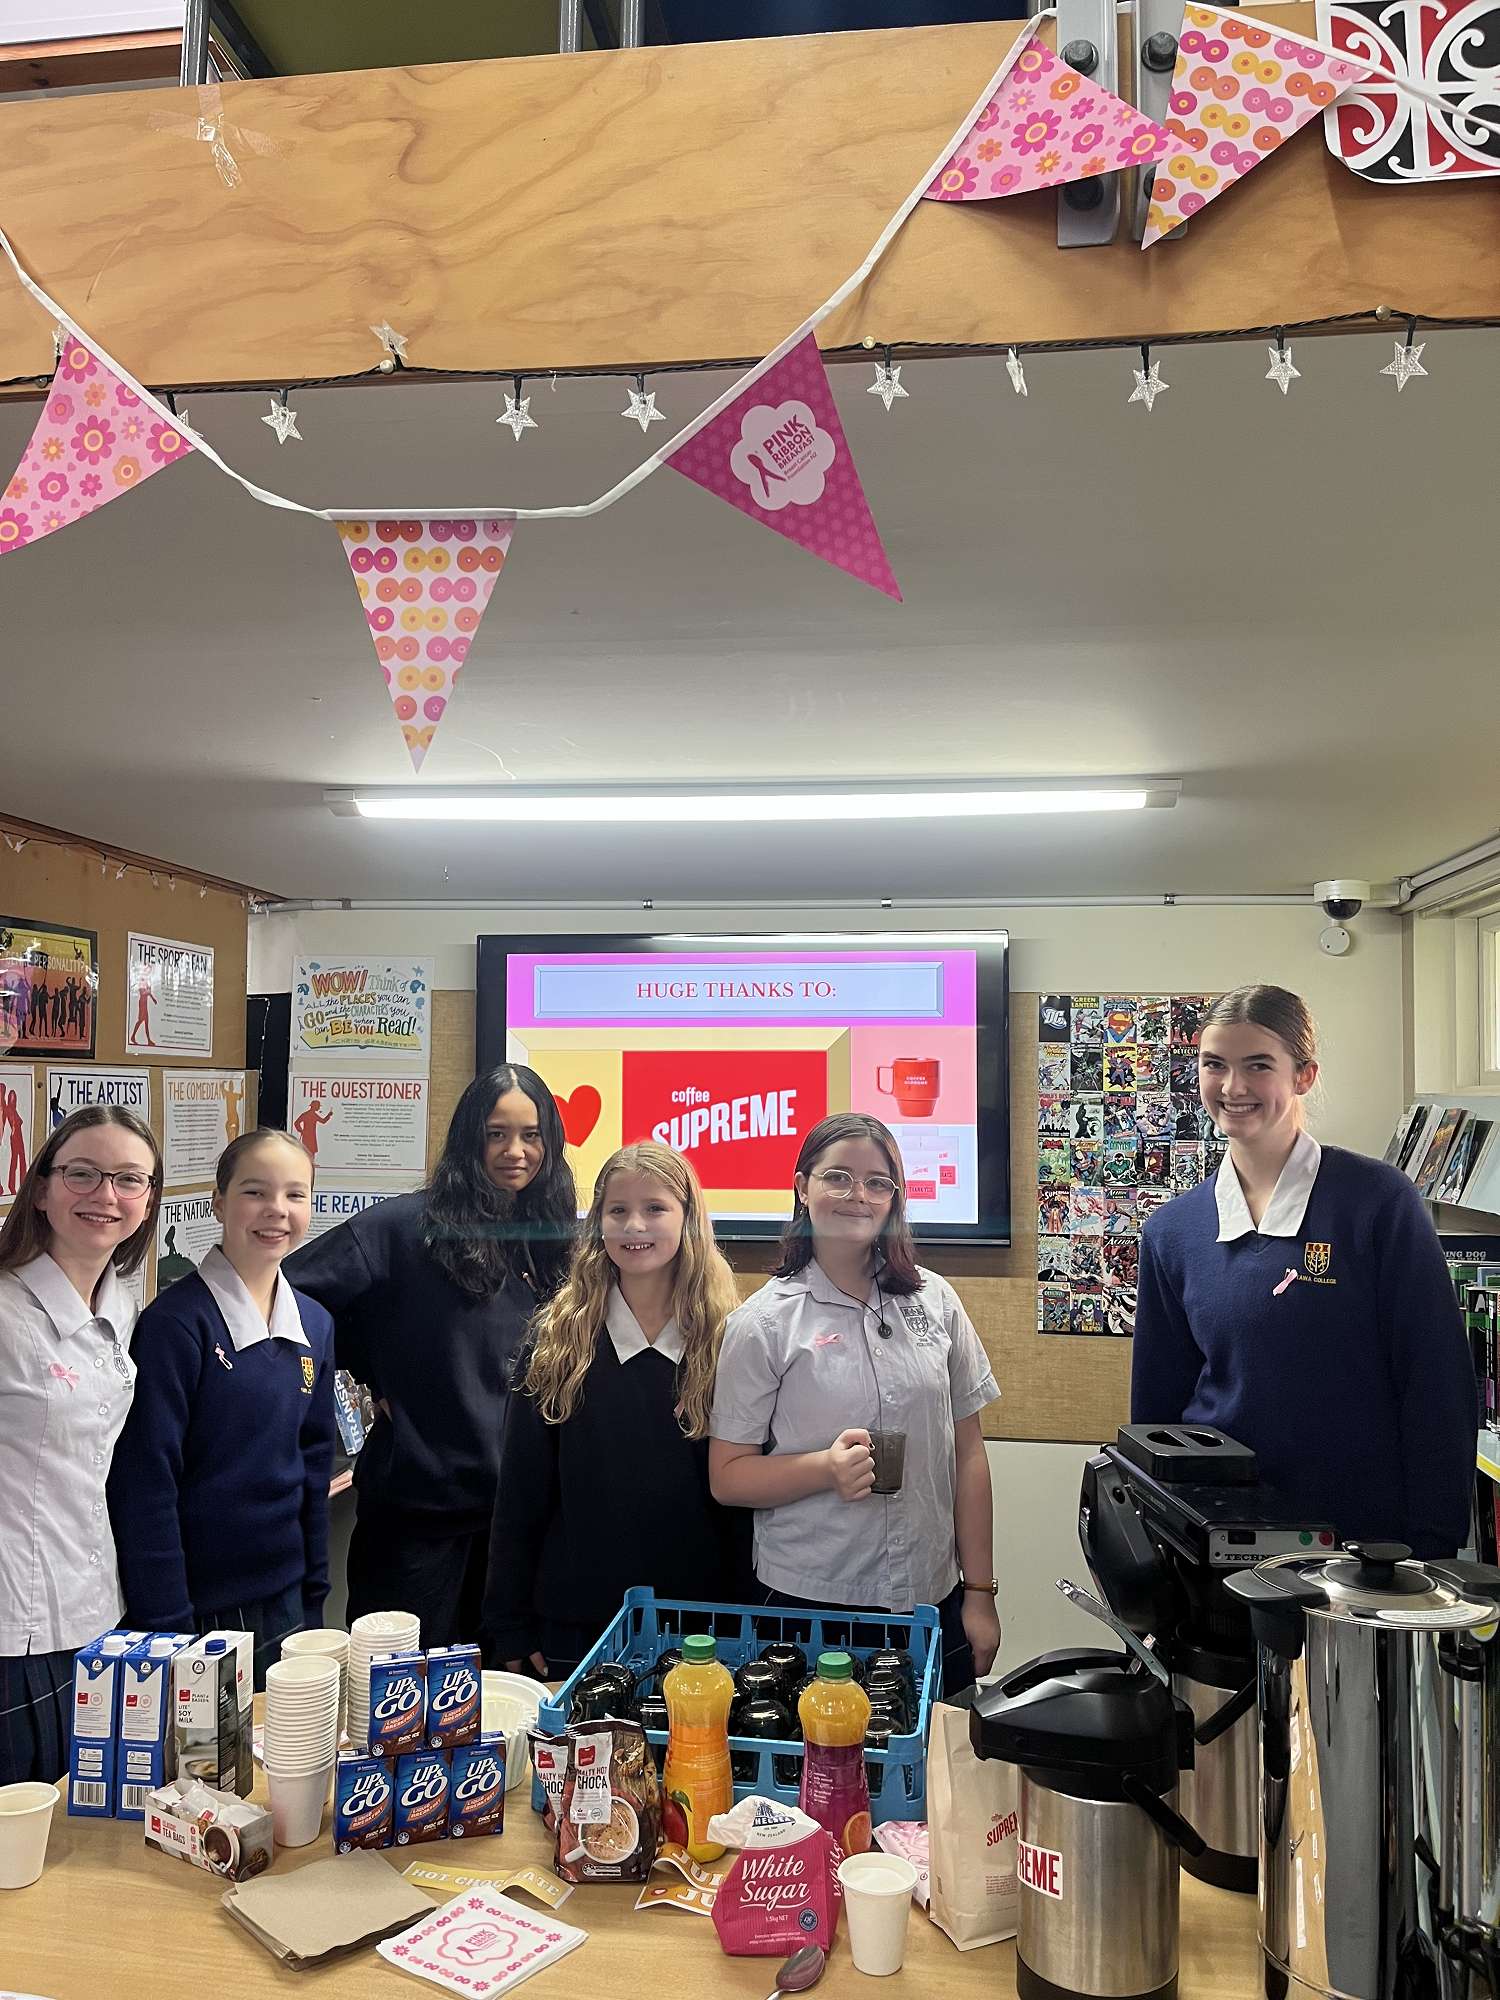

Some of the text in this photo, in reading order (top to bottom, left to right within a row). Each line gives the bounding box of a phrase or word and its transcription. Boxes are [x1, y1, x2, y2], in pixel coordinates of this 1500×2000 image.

[763, 414, 805, 454] PINK
[772, 426, 811, 463] RIBBON
[778, 434, 815, 469] BREAKFAST
[138, 944, 156, 965] THE
[191, 953, 208, 973] FAN
[312, 970, 368, 998] WOW!
[368, 974, 399, 992] Think
[637, 981, 837, 998] HUGE THANKS TO:
[340, 992, 376, 1005] PLACES
[303, 1010, 325, 1028] GO
[330, 1020, 353, 1035] BE
[375, 1017, 416, 1036] Read!
[68, 1080, 143, 1105] THE ARTIST
[168, 1082, 184, 1100] THE
[301, 1081, 422, 1100] THE QUESTIONER
[672, 1087, 710, 1107] coffee
[652, 1089, 797, 1153] SUPREME
[165, 1201, 214, 1224] THE NATURA
[312, 1195, 328, 1213] HE
[1225, 1553, 1272, 1561] TECHN
[385, 1677, 417, 1697] UP&
[443, 1669, 474, 1689] UP&
[375, 1689, 422, 1719] GO
[432, 1680, 479, 1710] GO
[413, 1764, 444, 1783] UP&
[467, 1757, 497, 1778] UP&
[577, 1766, 608, 1776] MALTY HOT
[354, 1772, 386, 1793] UP&
[401, 1776, 448, 1806] GO
[456, 1770, 502, 1799] GO
[541, 1780, 563, 1794] HOC
[577, 1775, 608, 1789] CHOCA
[342, 1784, 390, 1816] GO
[162, 1827, 185, 1844] TEA BAGS
[986, 1811, 1018, 1846] SUPRE
[412, 1869, 450, 1881] HOT
[672, 1849, 723, 1885] JUI
[742, 1854, 805, 1881] White
[1018, 1844, 1059, 1895] REME
[740, 1881, 810, 1912] Sugar
